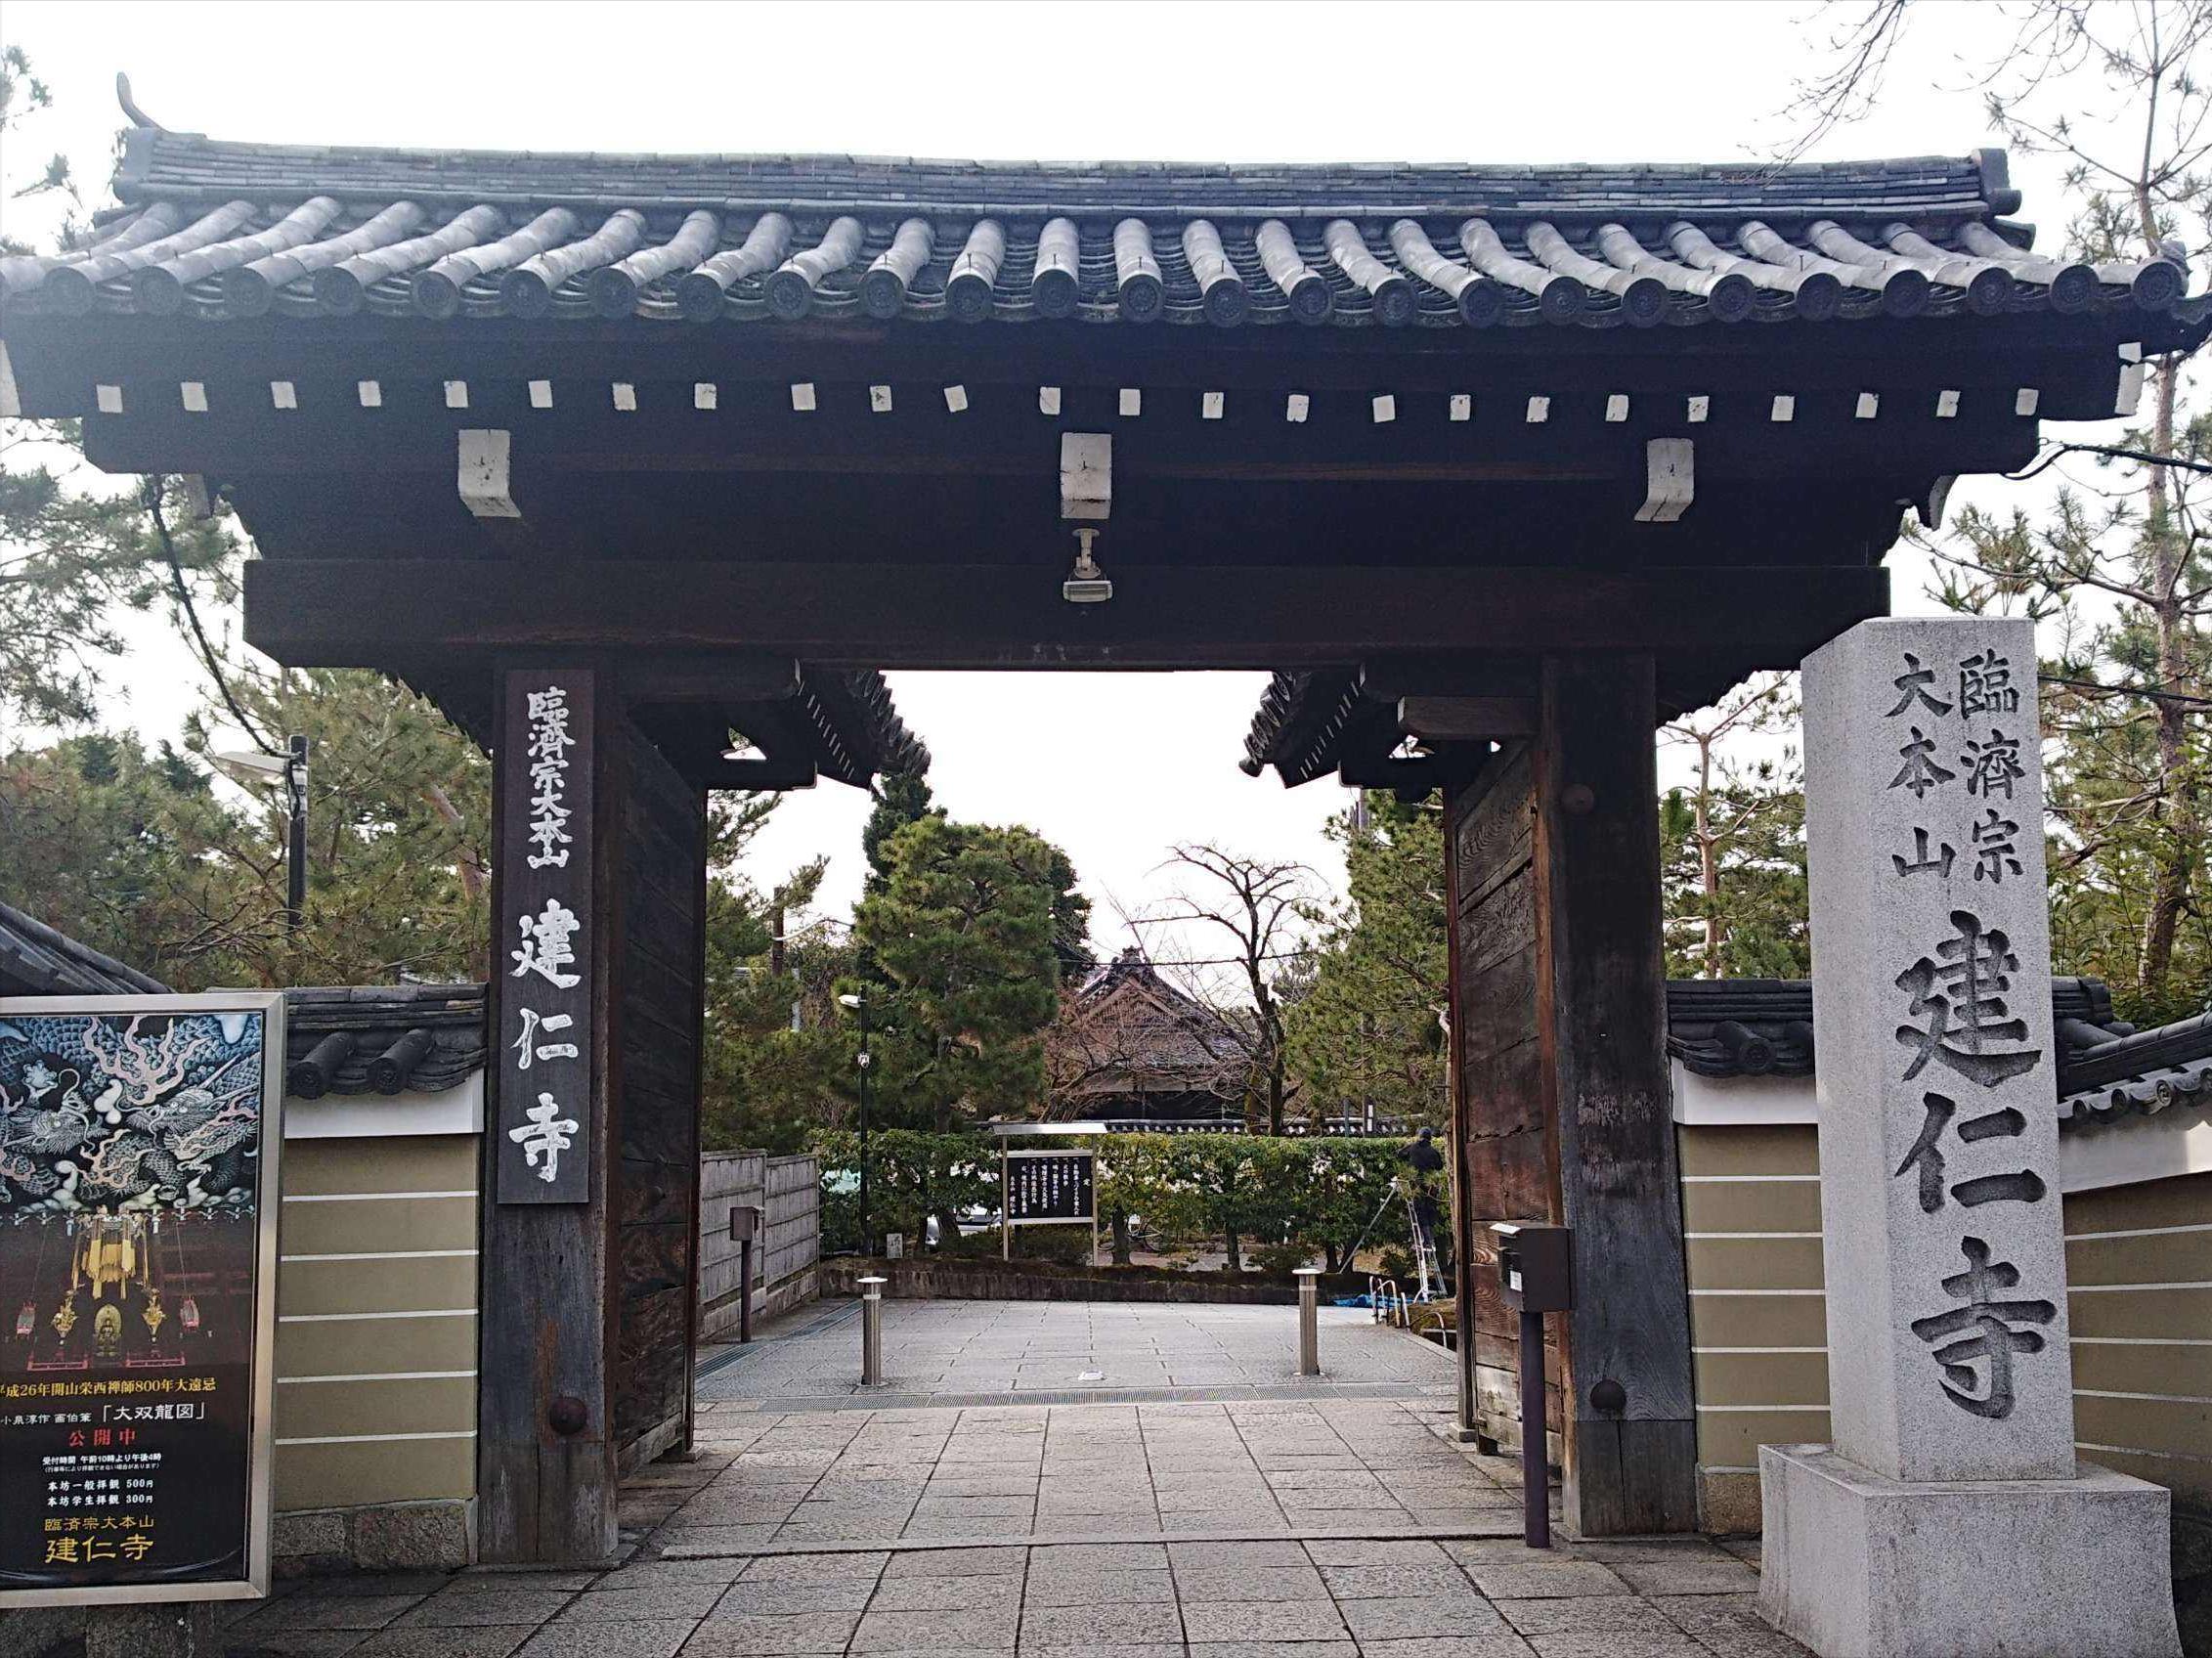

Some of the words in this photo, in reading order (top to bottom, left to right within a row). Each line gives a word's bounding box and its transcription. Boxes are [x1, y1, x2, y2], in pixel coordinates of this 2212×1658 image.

[1885, 652, 1955, 882] 大本山
[509, 897, 582, 1182] 建仁寺
[1894, 910, 2058, 1421] 建仁寺
[68, 1428, 136, 1447] 公開中
[44, 1514, 154, 1532] 臨済宗大本山
[45, 1533, 153, 1564] 建仁寺
